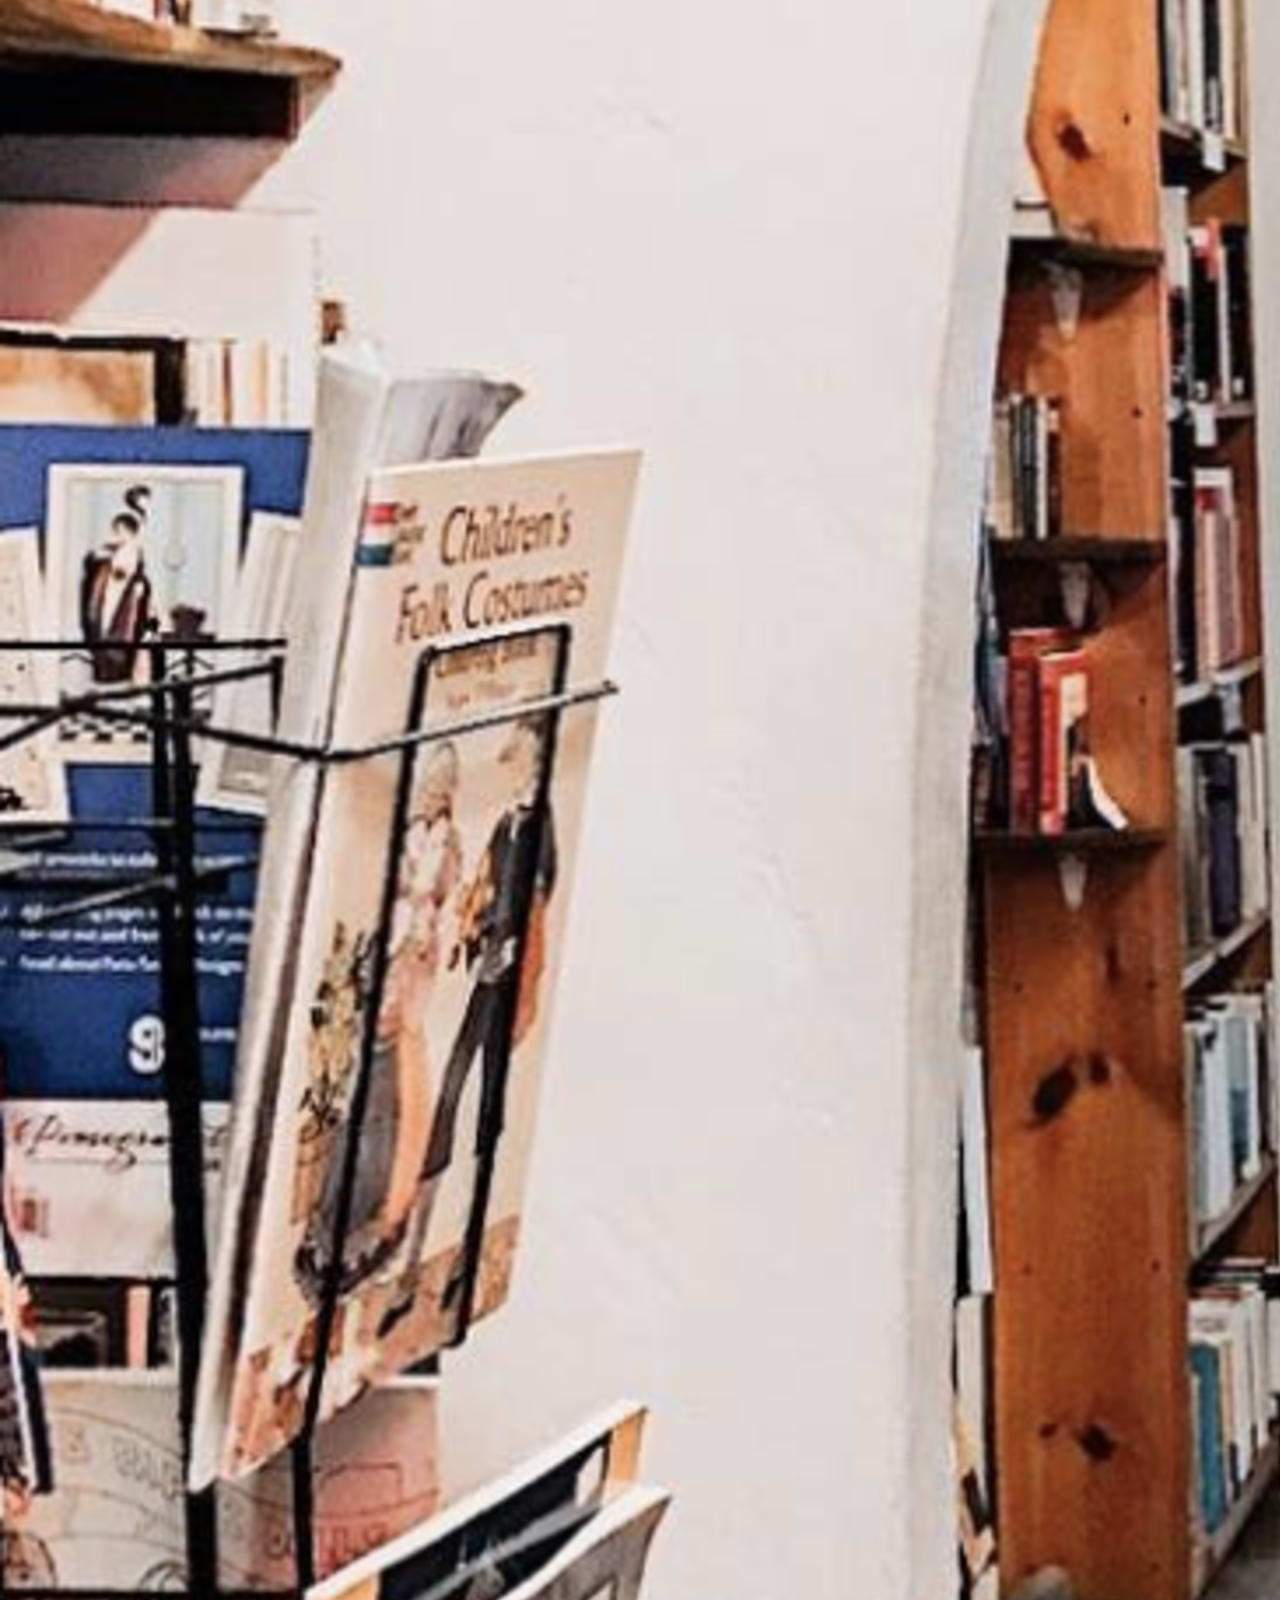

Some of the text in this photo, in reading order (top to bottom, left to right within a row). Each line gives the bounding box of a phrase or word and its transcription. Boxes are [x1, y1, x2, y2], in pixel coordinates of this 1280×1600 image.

[440, 494, 572, 567] Children's
[395, 571, 589, 644] Folk Costumes
